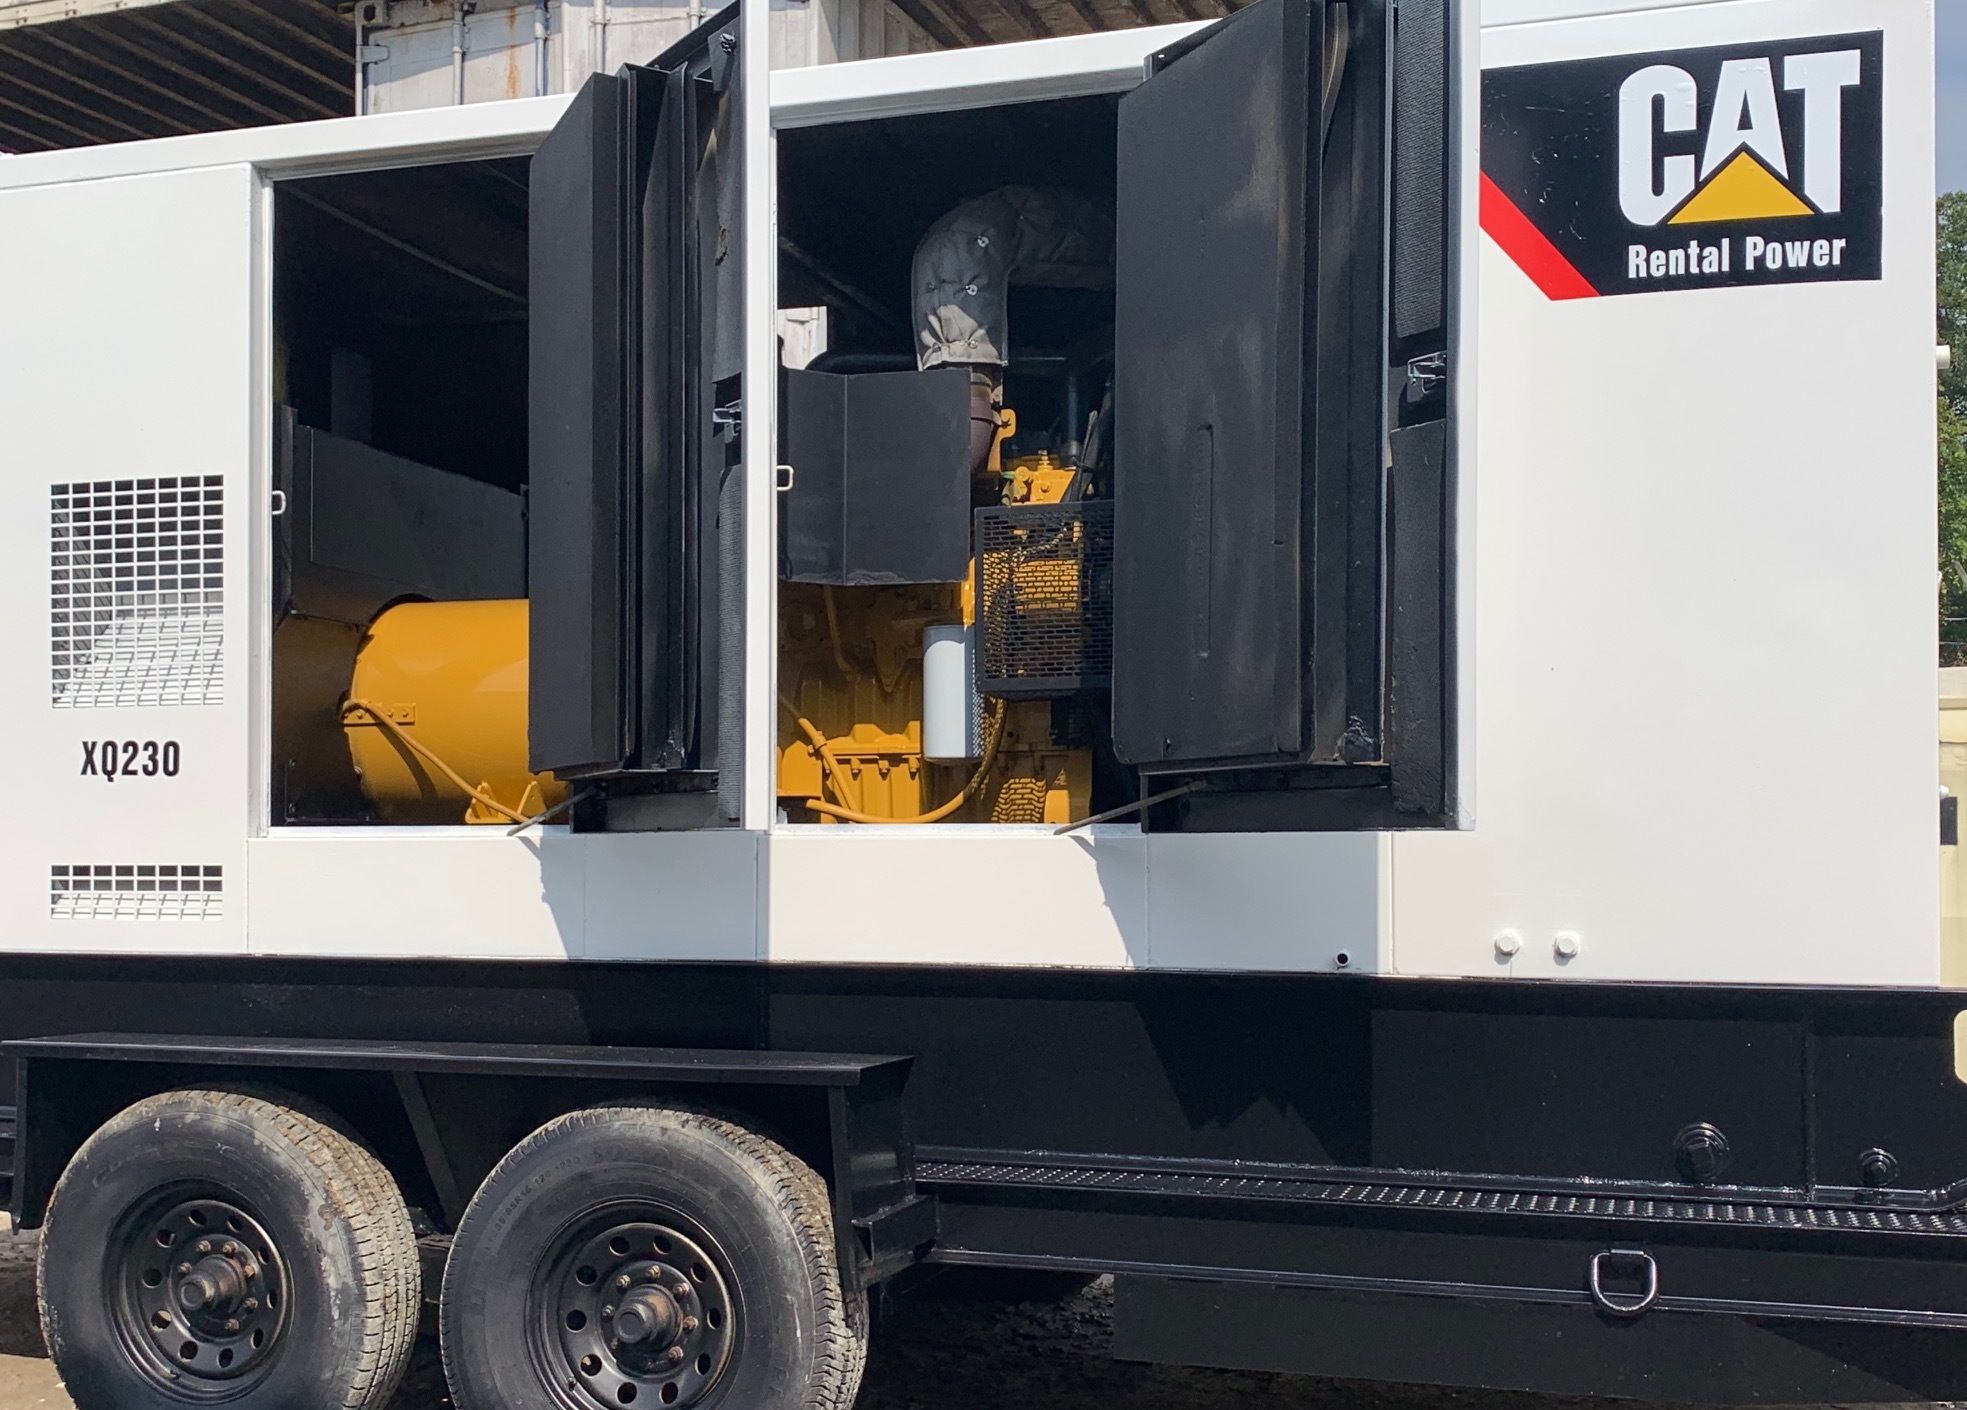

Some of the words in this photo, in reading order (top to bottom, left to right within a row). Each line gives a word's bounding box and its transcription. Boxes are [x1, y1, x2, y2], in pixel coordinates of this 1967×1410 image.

[1618, 49, 1861, 226] CAT
[1628, 237, 1730, 279] Rental
[1745, 236, 1847, 270] Power
[80, 740, 180, 782] XQ230
